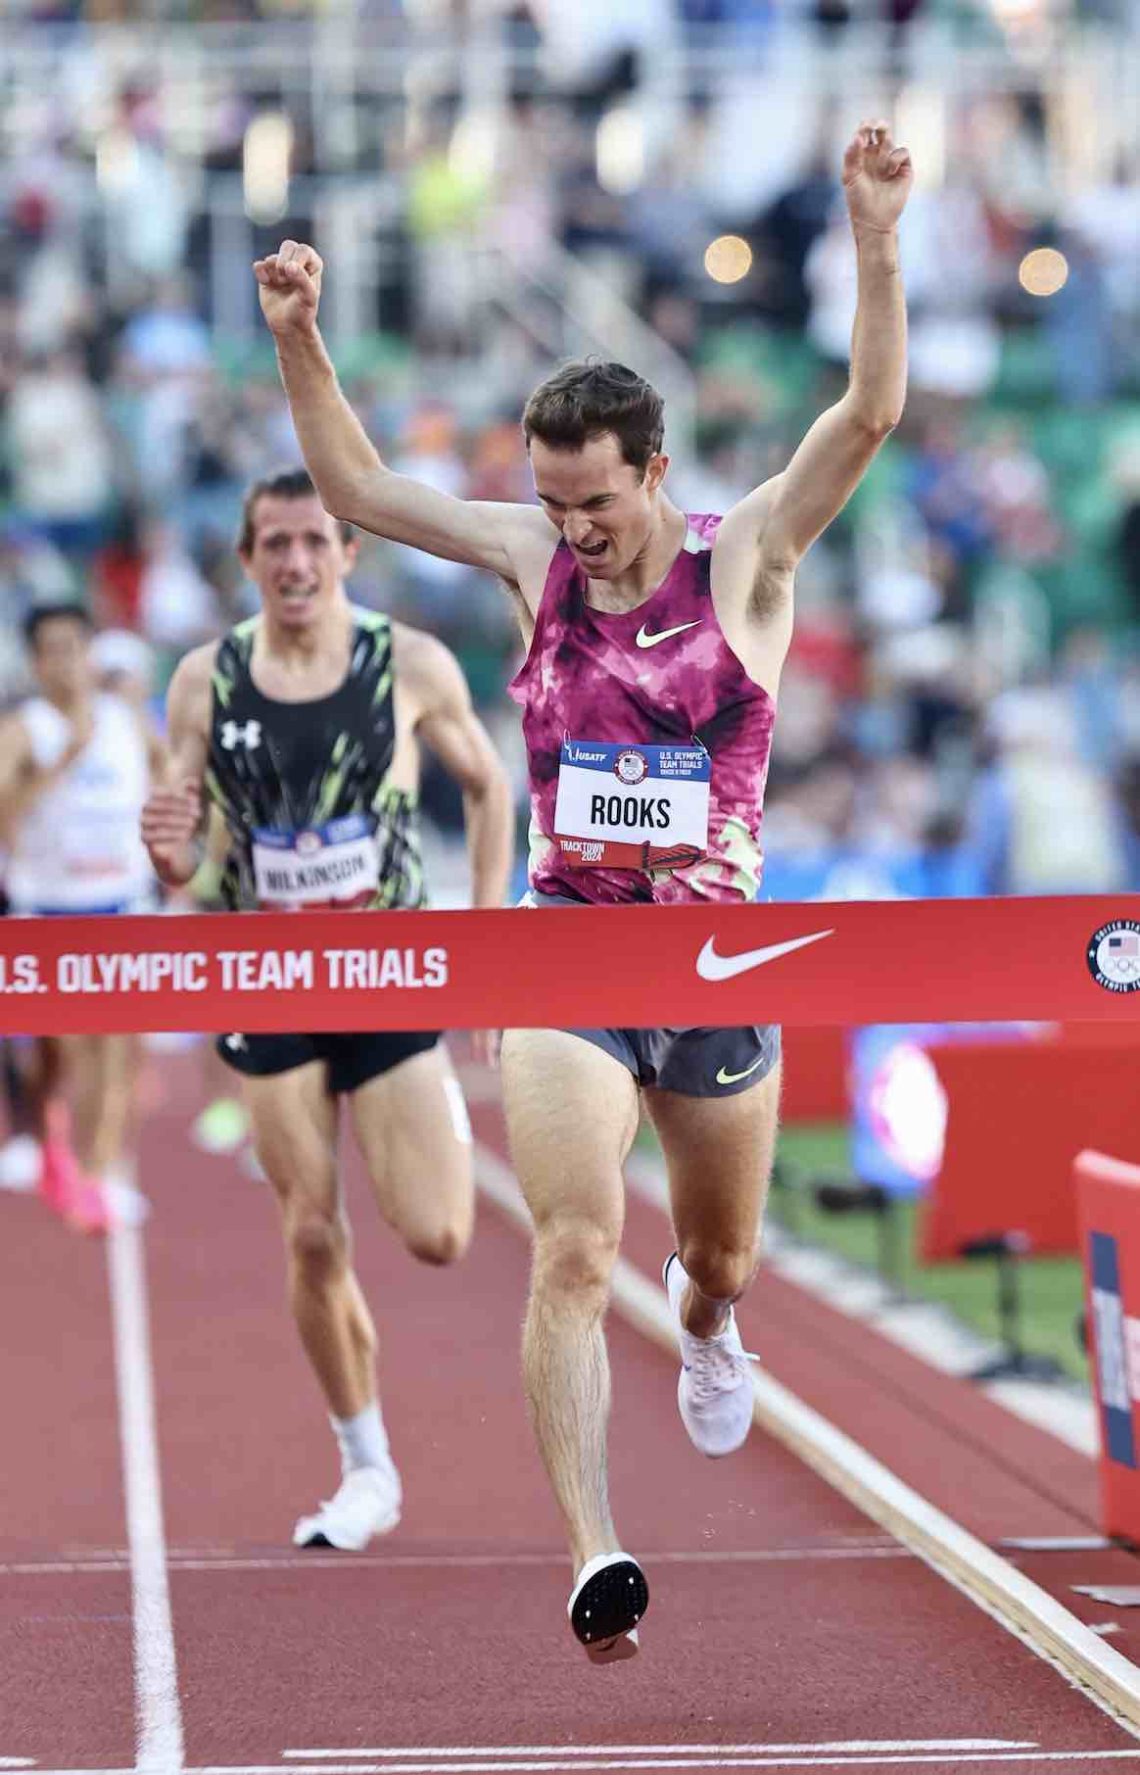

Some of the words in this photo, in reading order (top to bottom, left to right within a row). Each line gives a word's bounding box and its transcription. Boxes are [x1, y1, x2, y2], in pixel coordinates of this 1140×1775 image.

[659, 760, 678, 769] TEAM
[679, 760, 703, 769] TRIALS
[674, 751, 703, 761] OLYMPIC
[590, 794, 671, 829] ROOKS
[0, 953, 48, 994] .S.
[57, 952, 208, 993] OLYMPIC
[216, 950, 314, 990] TEAM
[323, 948, 448, 988] TRIALS
